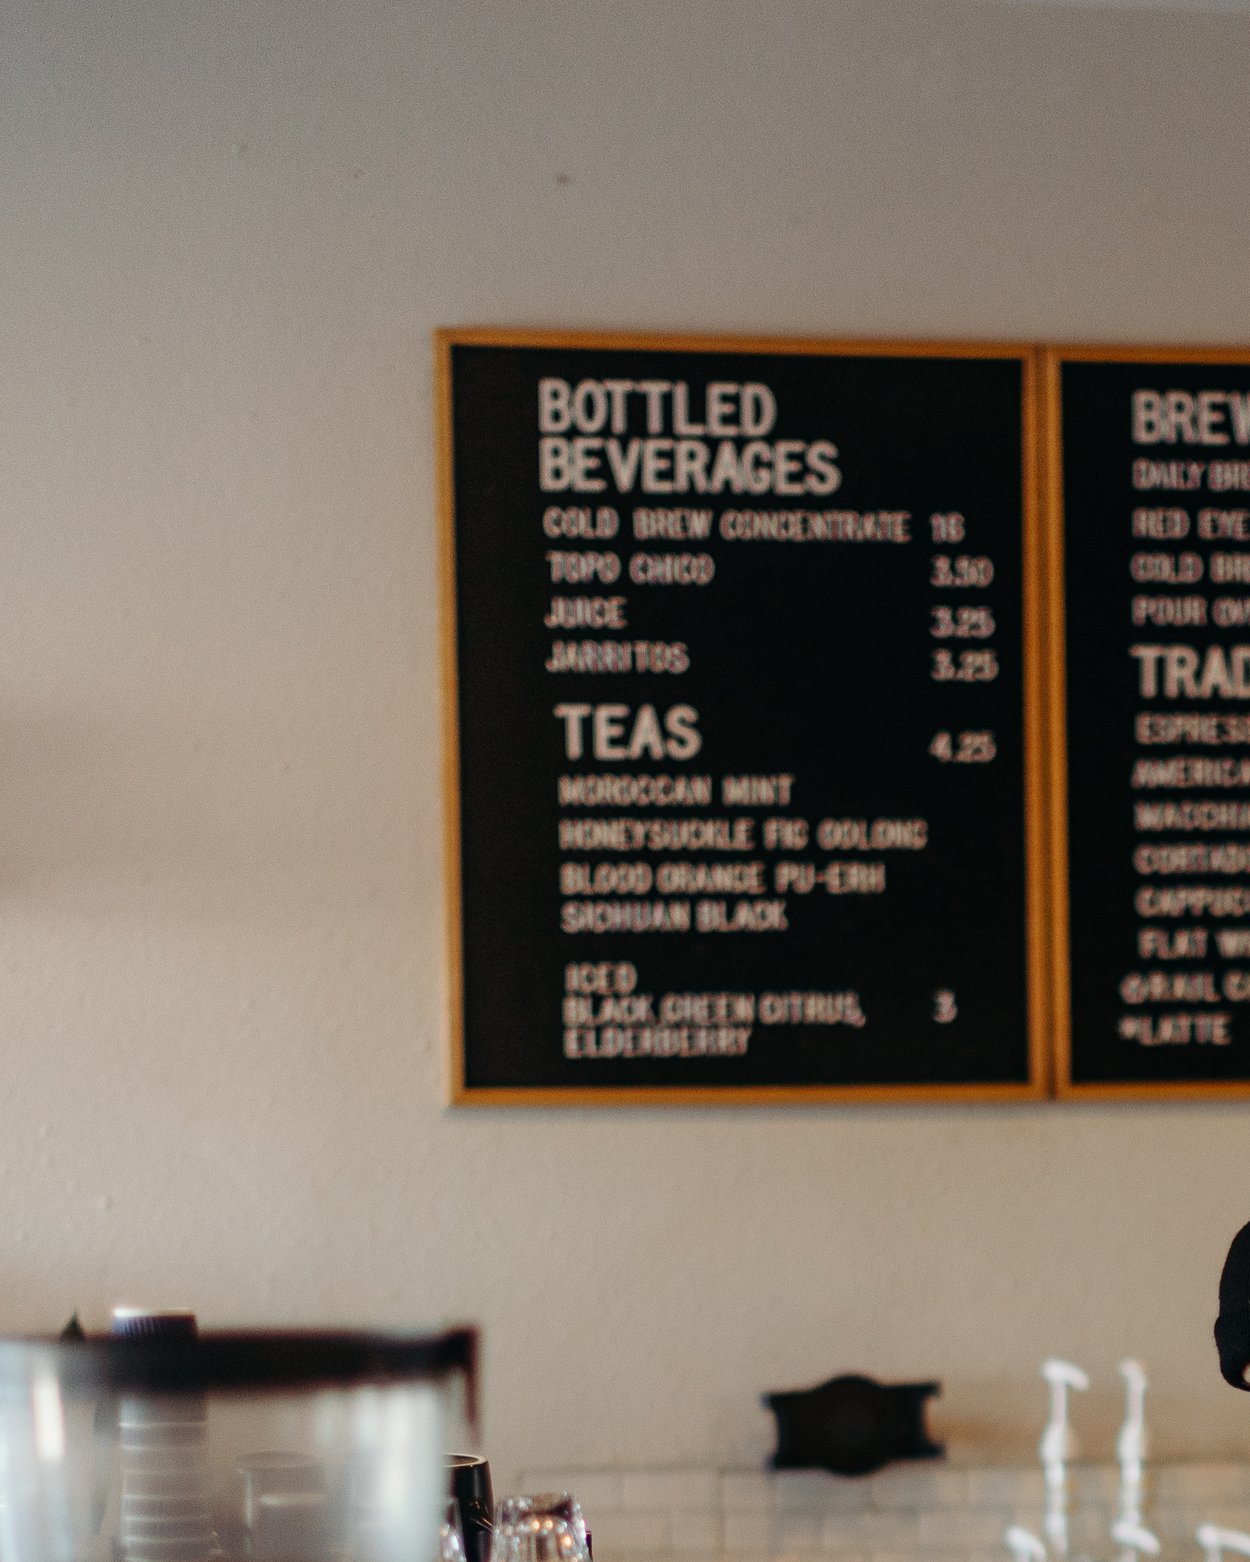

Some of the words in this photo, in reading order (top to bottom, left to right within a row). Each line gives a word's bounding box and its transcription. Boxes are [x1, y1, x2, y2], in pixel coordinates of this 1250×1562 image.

[538, 377, 777, 437] BOTTLED
[538, 437, 842, 496] BEVERAGES
[1131, 458, 1204, 491] DAILY
[543, 506, 619, 540] COLD
[633, 508, 712, 541] BREW
[720, 509, 911, 543] CONCENTRATE
[1132, 507, 1190, 540] RED
[545, 550, 621, 585] TOPO
[629, 553, 715, 585] CHICO
[929, 556, 994, 588] 3.50
[1129, 552, 1204, 583] COLD
[544, 595, 628, 628] JUICE
[930, 606, 995, 638] 3.25
[1131, 594, 1208, 627] POUR
[545, 640, 690, 674] JARRITOS
[930, 649, 998, 682] 3.25
[554, 704, 701, 761] TEAS
[928, 731, 997, 764] 4.25
[558, 774, 711, 806] MOROCCAN
[722, 774, 795, 806] MINT
[559, 818, 755, 851] HONEYSUCKLE
[763, 818, 809, 851] FIG
[817, 818, 928, 851] OOLONG
[560, 861, 653, 894] BLOOD
[656, 861, 765, 894] ORANGE
[560, 900, 691, 933] SICHUAN
[696, 900, 789, 933] BLACK
[1137, 928, 1208, 959] FLAT
[564, 961, 638, 995] ICED
[660, 993, 756, 1026] GREEN
[933, 989, 957, 1024] 3
[563, 1026, 752, 1059] ELDERBERRY
